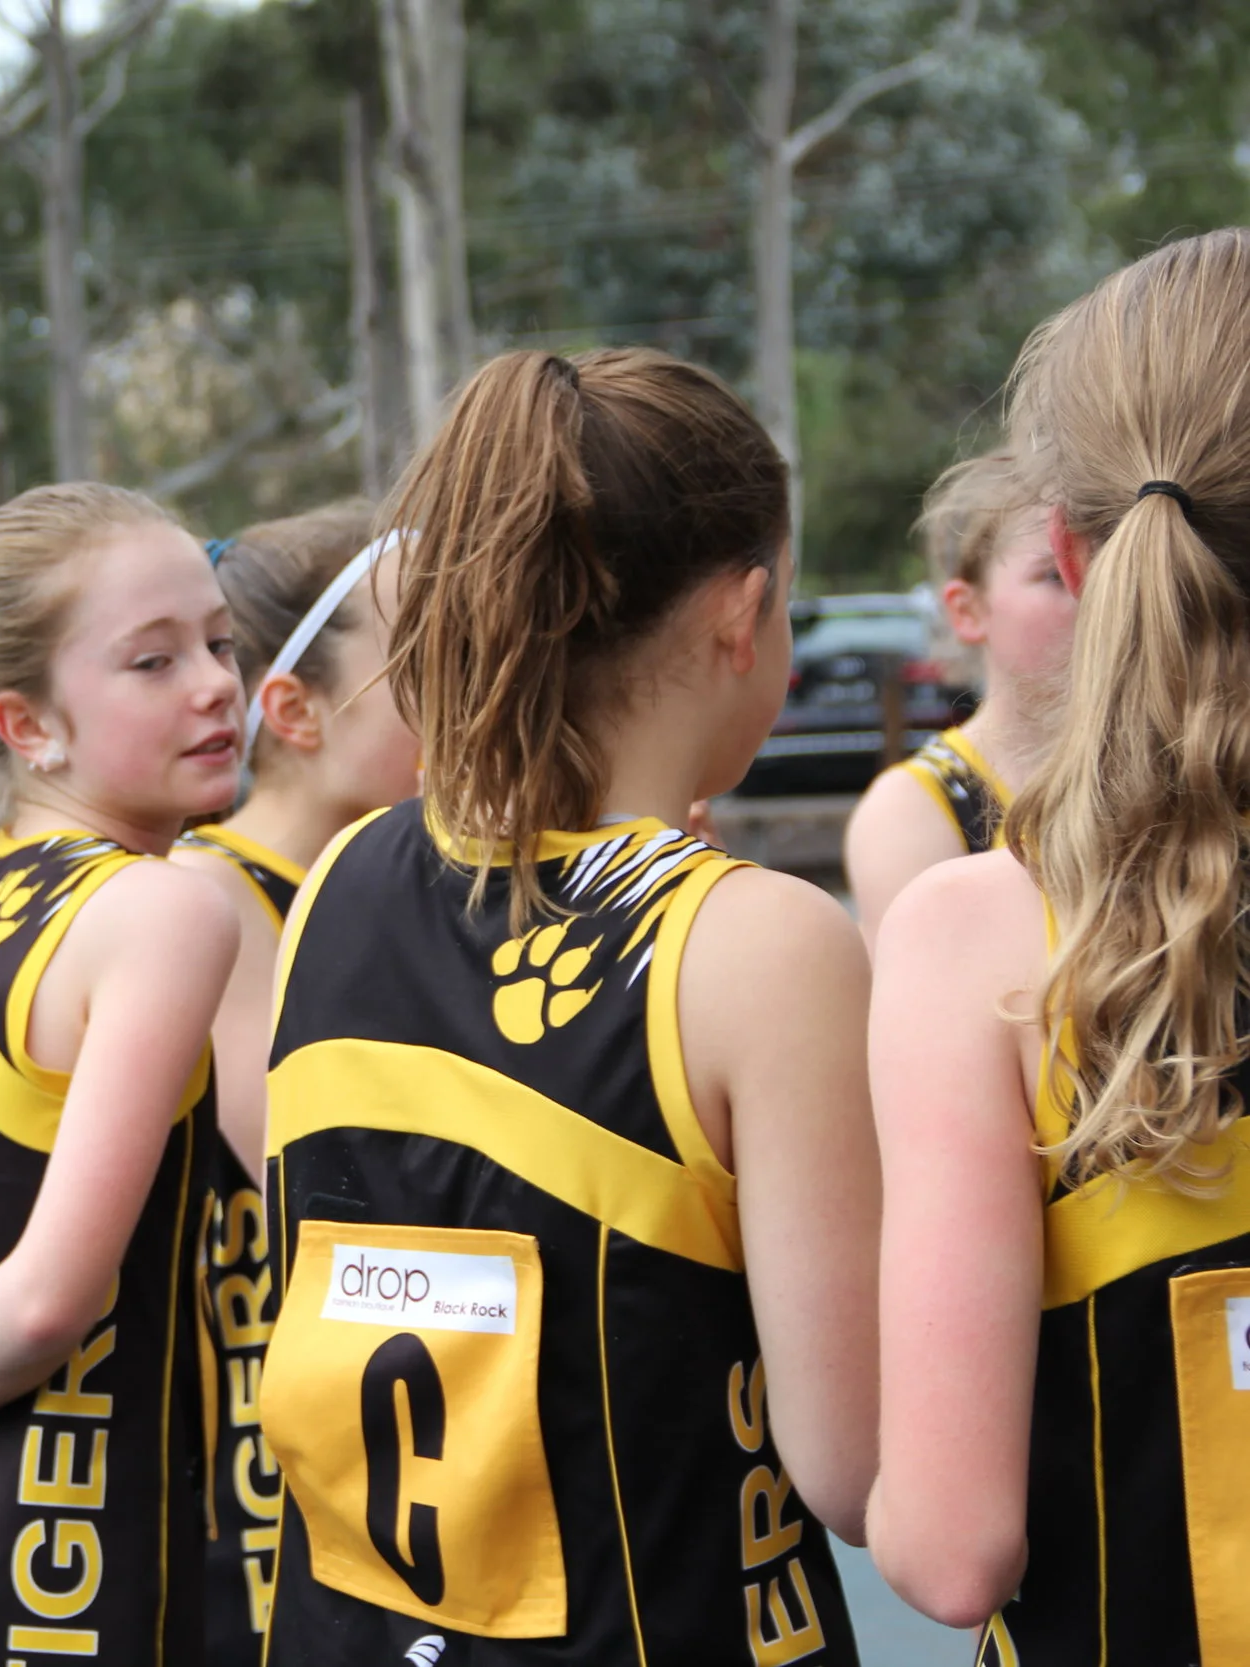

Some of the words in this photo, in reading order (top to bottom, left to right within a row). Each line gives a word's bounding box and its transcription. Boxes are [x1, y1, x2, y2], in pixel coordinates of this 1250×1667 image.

[213, 1188, 281, 1634] TIGERS
[341, 1253, 430, 1312] drop
[433, 1300, 467, 1316] Black
[470, 1302, 508, 1318] Rock
[6, 1268, 121, 1667] IGER
[360, 1331, 447, 1607] C
[728, 1353, 827, 1667] ERS
